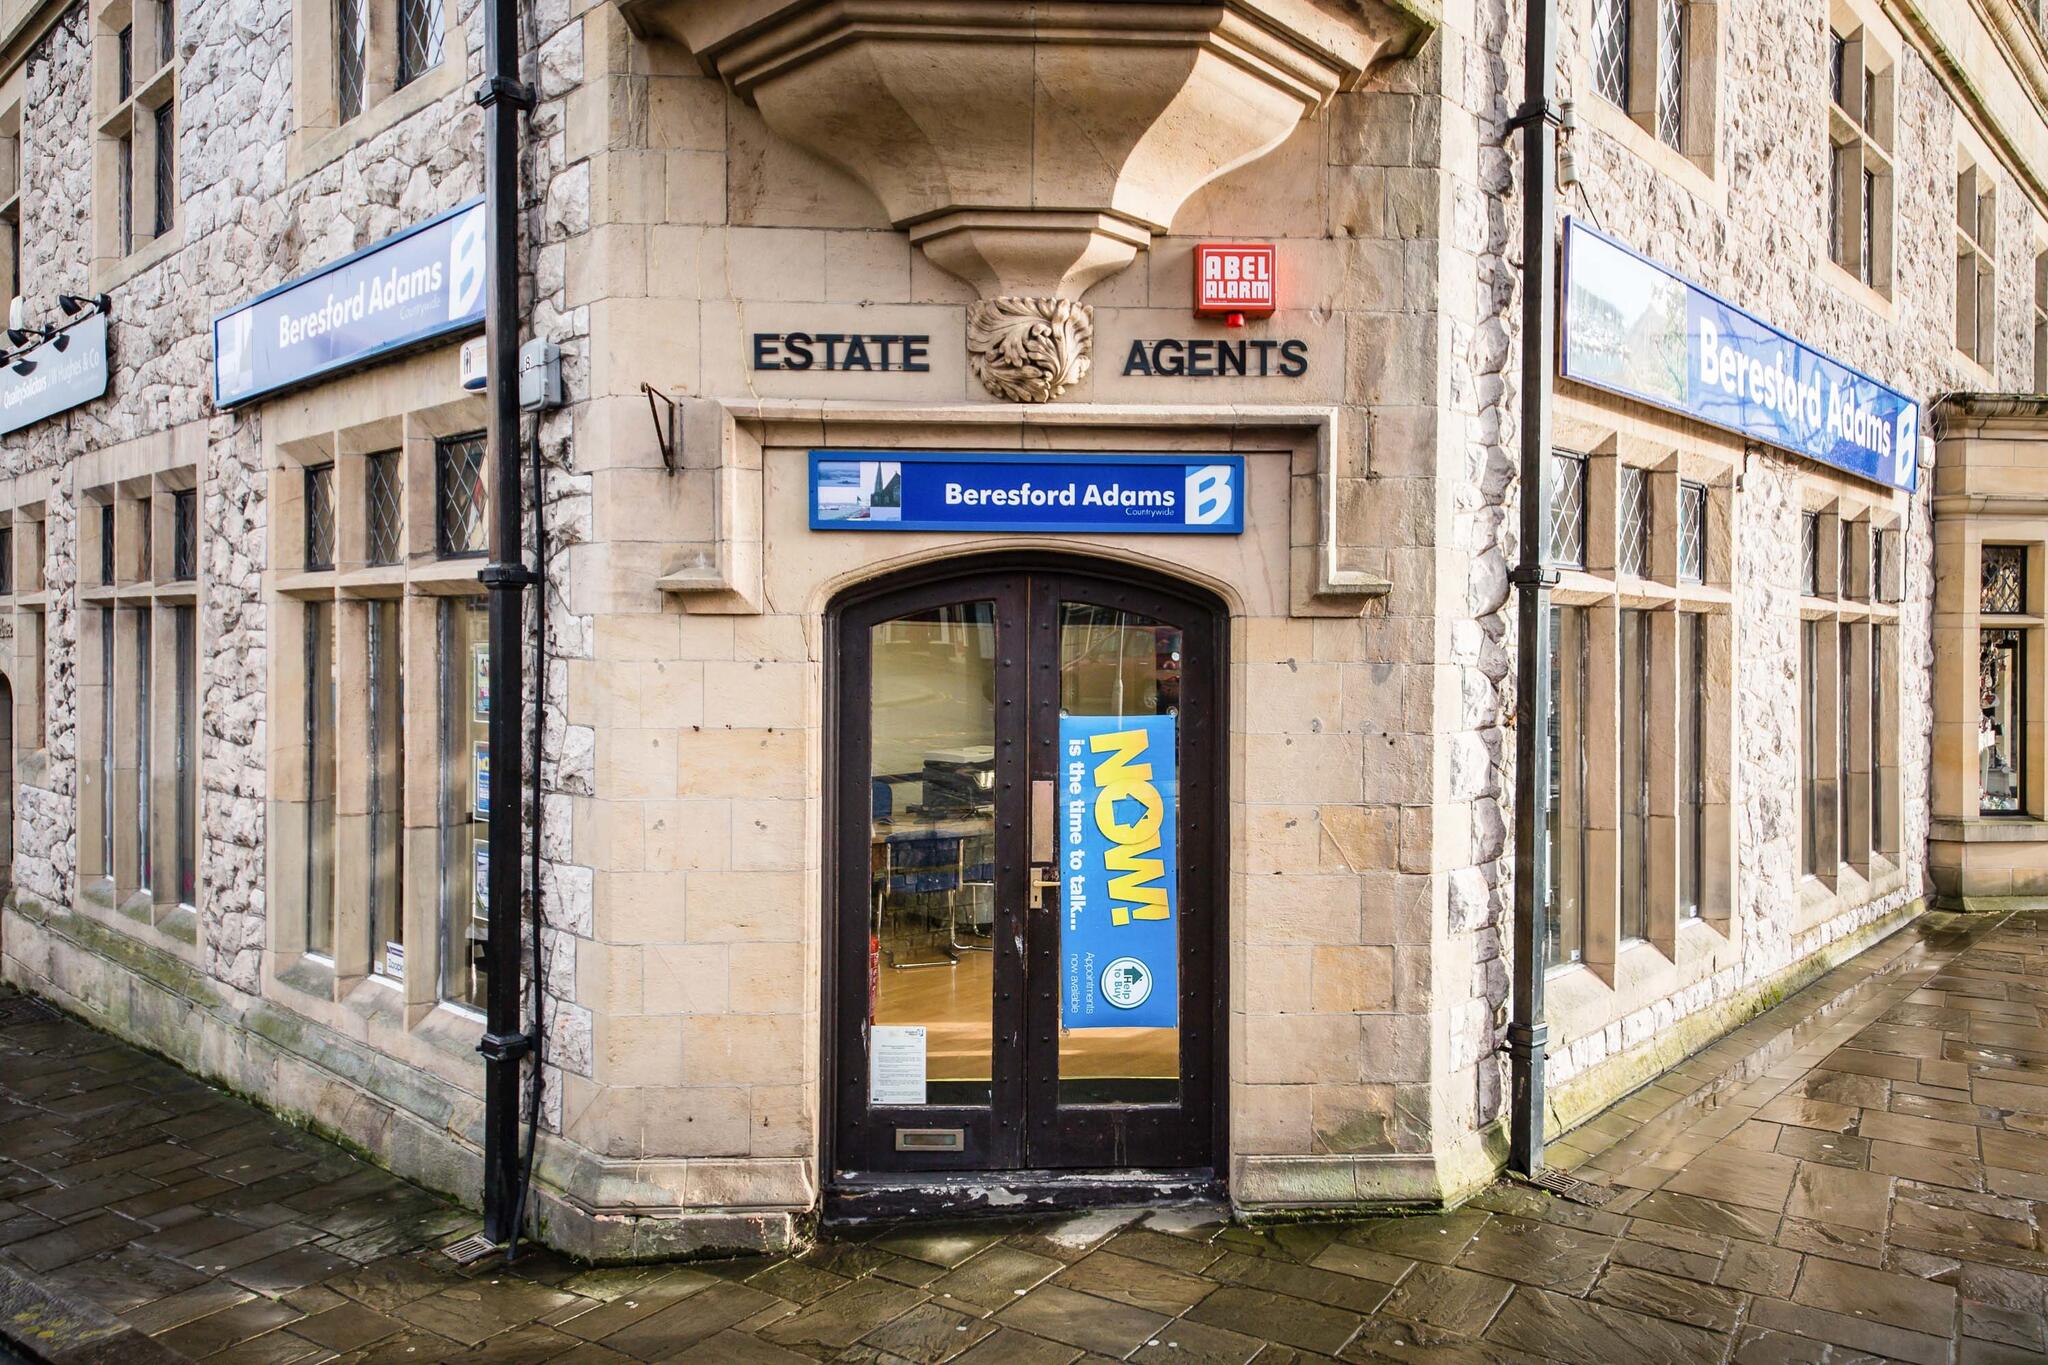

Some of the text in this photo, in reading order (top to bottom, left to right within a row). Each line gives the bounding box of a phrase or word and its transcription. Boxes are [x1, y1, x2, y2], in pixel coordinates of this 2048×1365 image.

[1205, 255, 1269, 280] ABEL
[279, 260, 443, 349] Beresford Adams
[1205, 281, 1269, 299] ALARM
[753, 332, 1309, 378] ESTATE AGENTS
[1700, 316, 1892, 458] Beresford Adams
[1895, 403, 1916, 486] B
[945, 482, 1175, 507] Beresford Adams
[1125, 507, 1175, 518] Countrywide
[1185, 465, 1233, 525] B
[1068, 739, 1086, 757] is
[1068, 761, 1086, 795] the
[1069, 800, 1086, 845] time
[1089, 728, 1171, 927] NOW!
[1069, 849, 1086, 871] to
[1070, 953, 1080, 1014] now available
[1083, 952, 1096, 1015] Appointments
[1112, 981, 1122, 999] Buy
[1121, 976, 1132, 1000] Help
